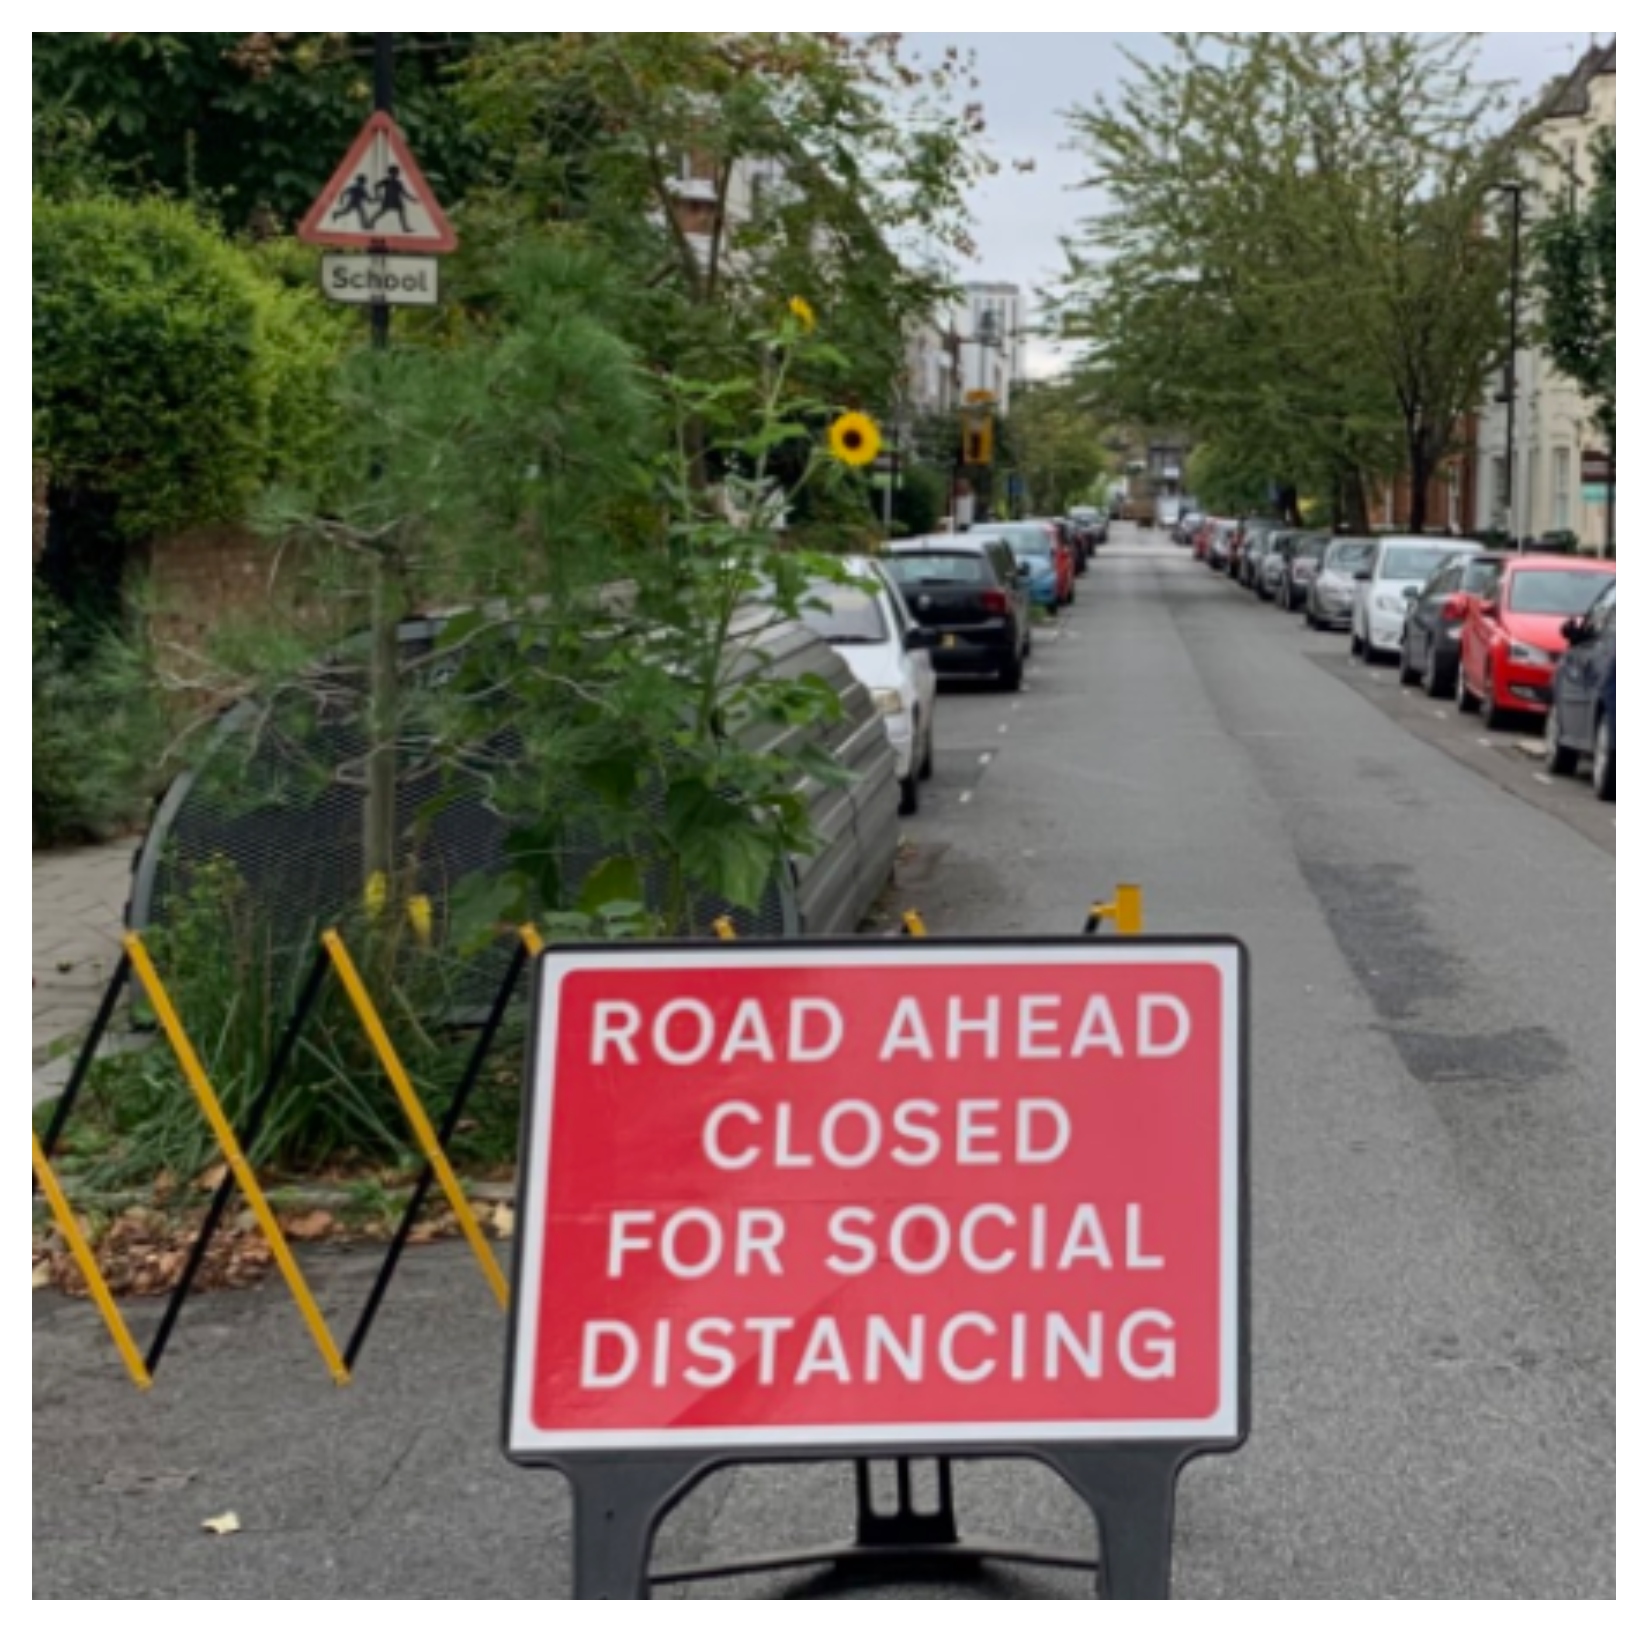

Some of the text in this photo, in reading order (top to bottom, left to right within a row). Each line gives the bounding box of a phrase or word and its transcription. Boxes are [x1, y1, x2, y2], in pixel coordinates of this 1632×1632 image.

[332, 265, 428, 292] School
[590, 993, 1191, 1065] ROAD AHEAD
[703, 1098, 1072, 1169] CLOSED
[606, 1202, 1166, 1279] FOR SOCIAL
[579, 1309, 1177, 1389] DISTANCING
